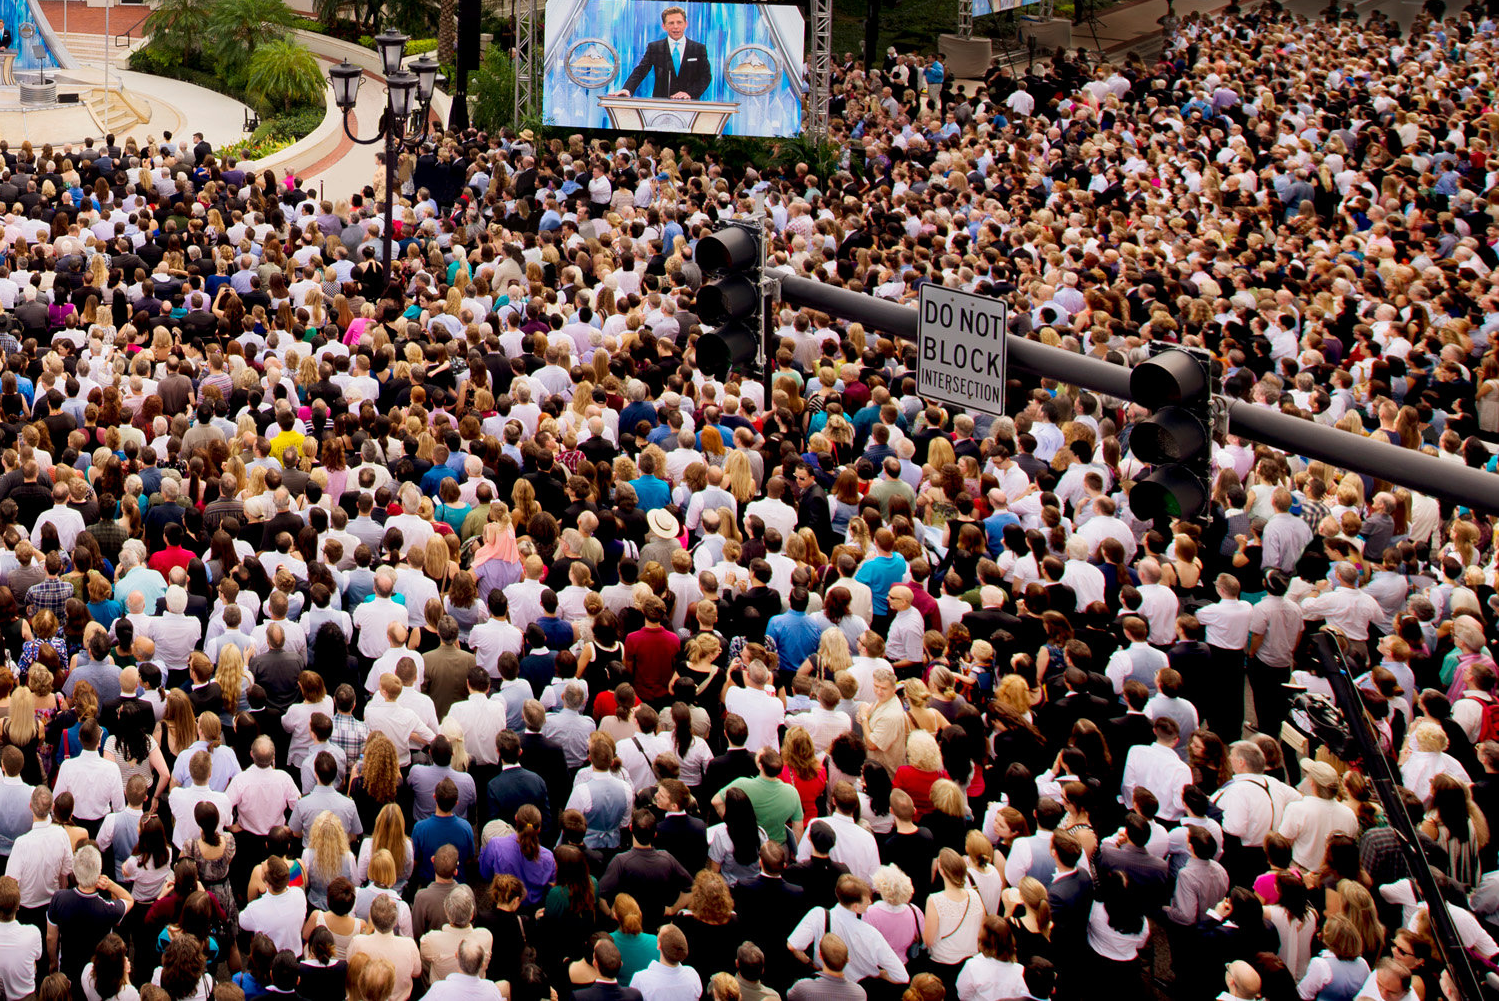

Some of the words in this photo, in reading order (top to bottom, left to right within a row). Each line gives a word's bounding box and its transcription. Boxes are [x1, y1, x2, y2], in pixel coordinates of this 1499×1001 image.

[925, 300, 952, 328] DO
[960, 308, 1002, 340] NOT
[924, 336, 1000, 378] BLOCK
[922, 368, 1000, 404] INTERSECTION
